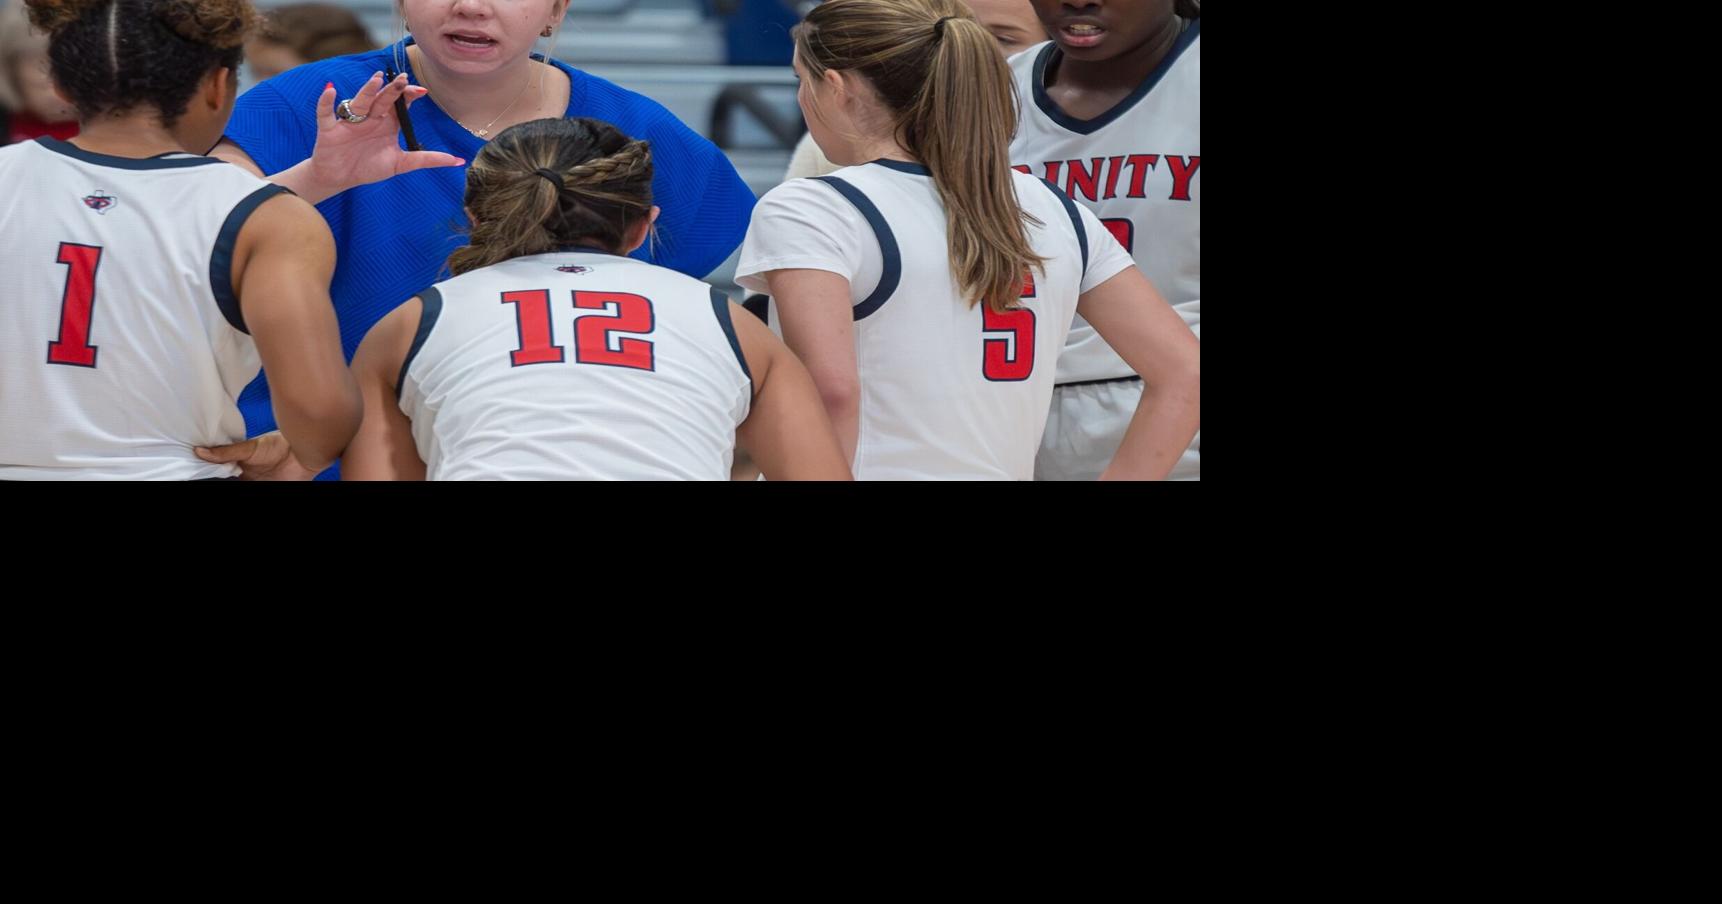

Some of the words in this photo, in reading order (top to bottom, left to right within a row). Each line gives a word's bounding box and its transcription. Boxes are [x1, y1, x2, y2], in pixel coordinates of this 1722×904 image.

[1010, 153, 1200, 202] INITY
[47, 241, 104, 369] 1
[500, 288, 655, 372] 12
[980, 265, 1037, 382] 5
